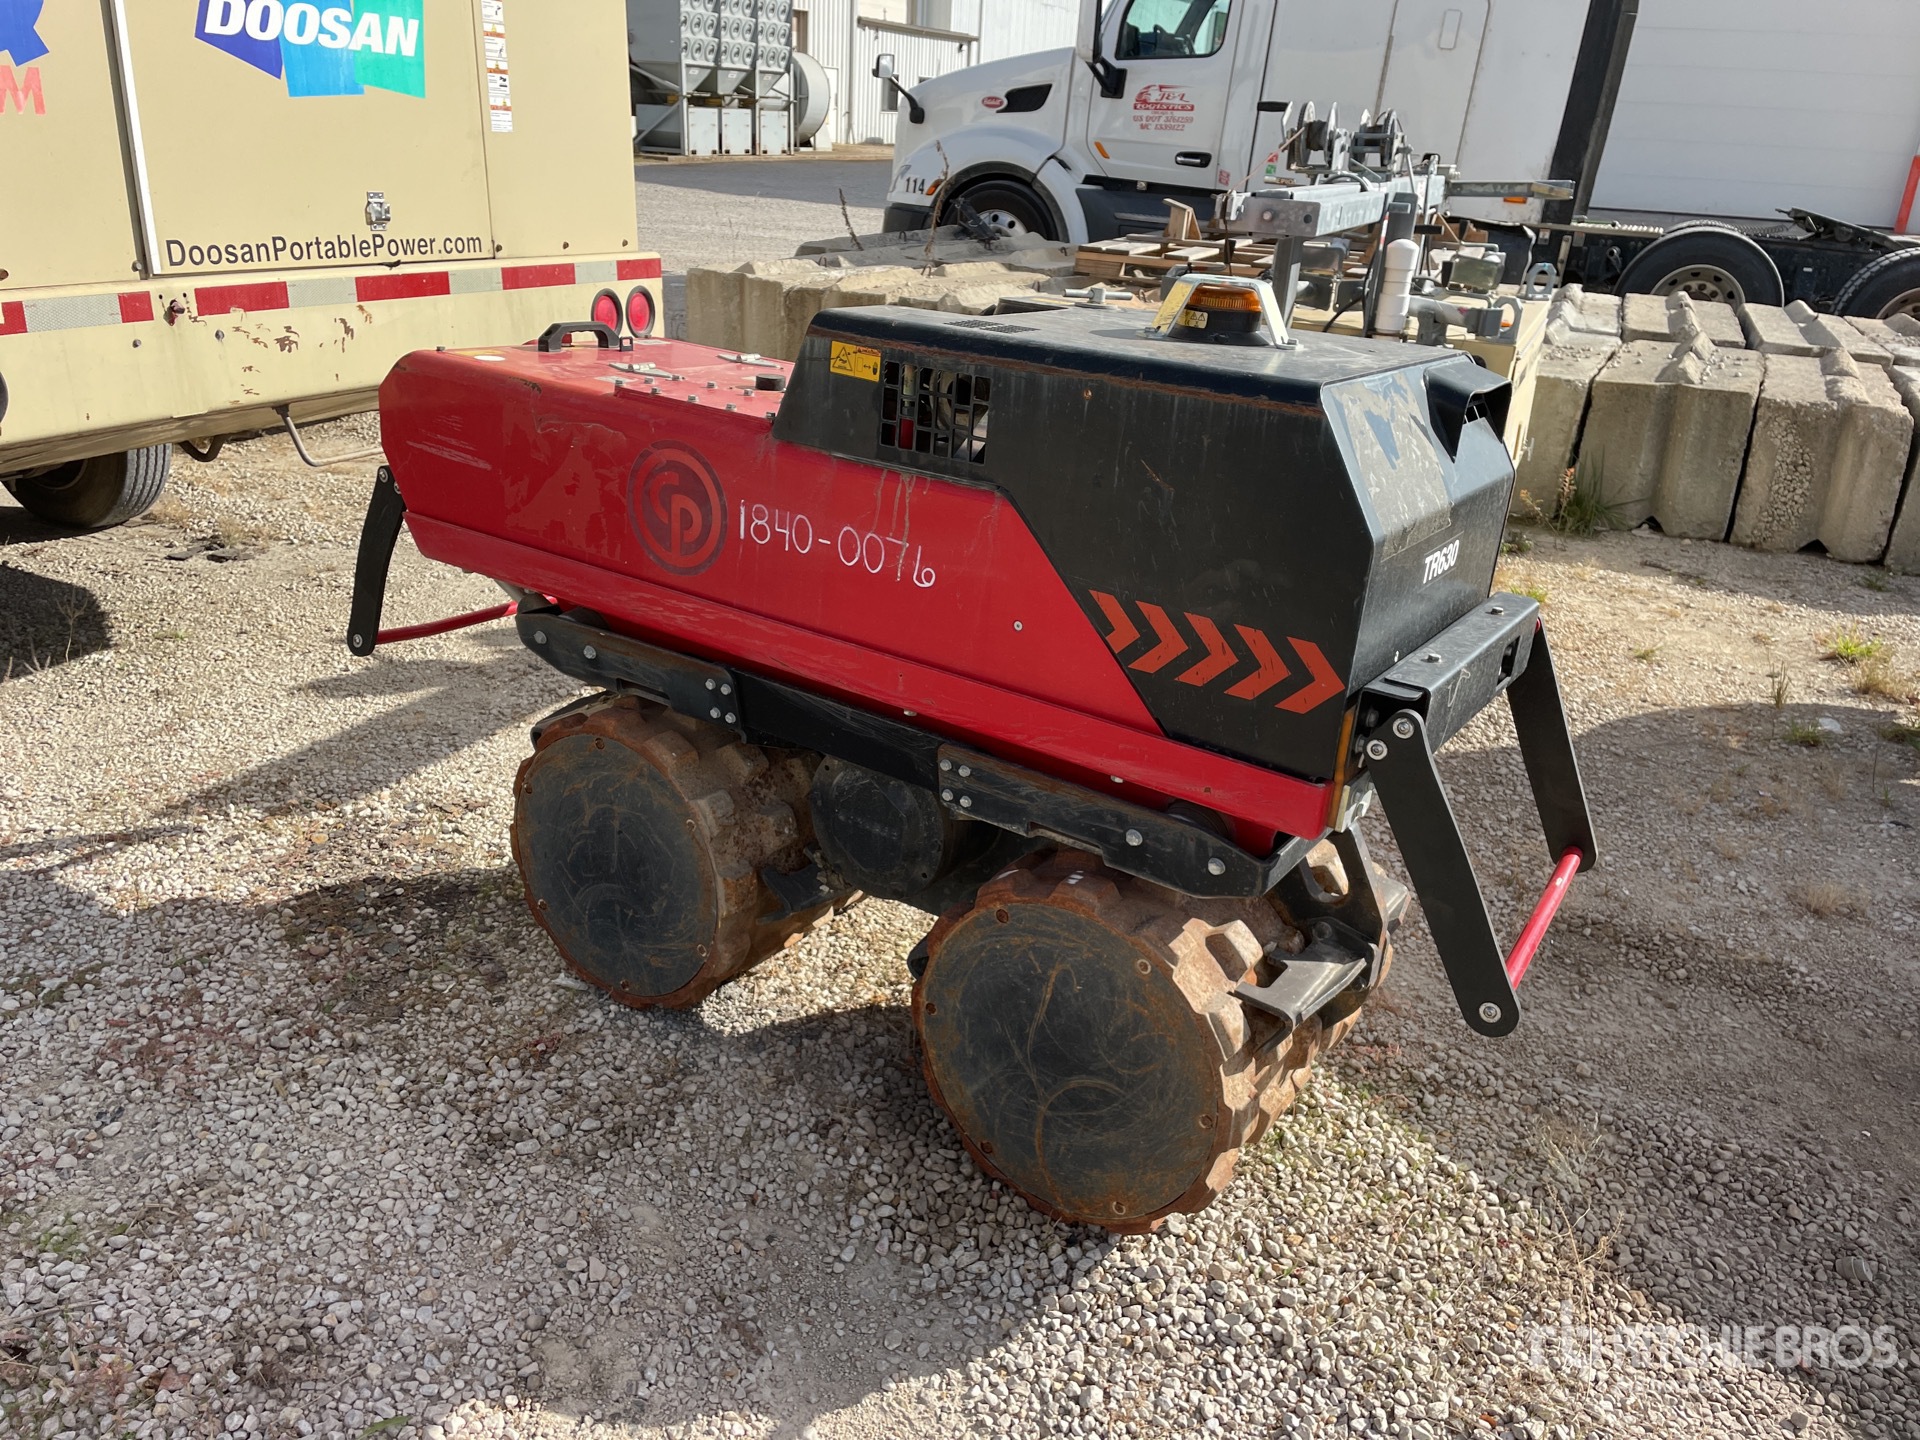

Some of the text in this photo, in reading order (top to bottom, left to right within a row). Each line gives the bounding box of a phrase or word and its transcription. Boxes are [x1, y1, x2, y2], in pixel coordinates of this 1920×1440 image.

[204, 0, 419, 57] DOOSAN
[905, 176, 925, 195] 114
[165, 234, 483, 267] DoosanPortablePower.com
[739, 498, 936, 588] 1840-0076
[1423, 539, 1459, 584] TR630
